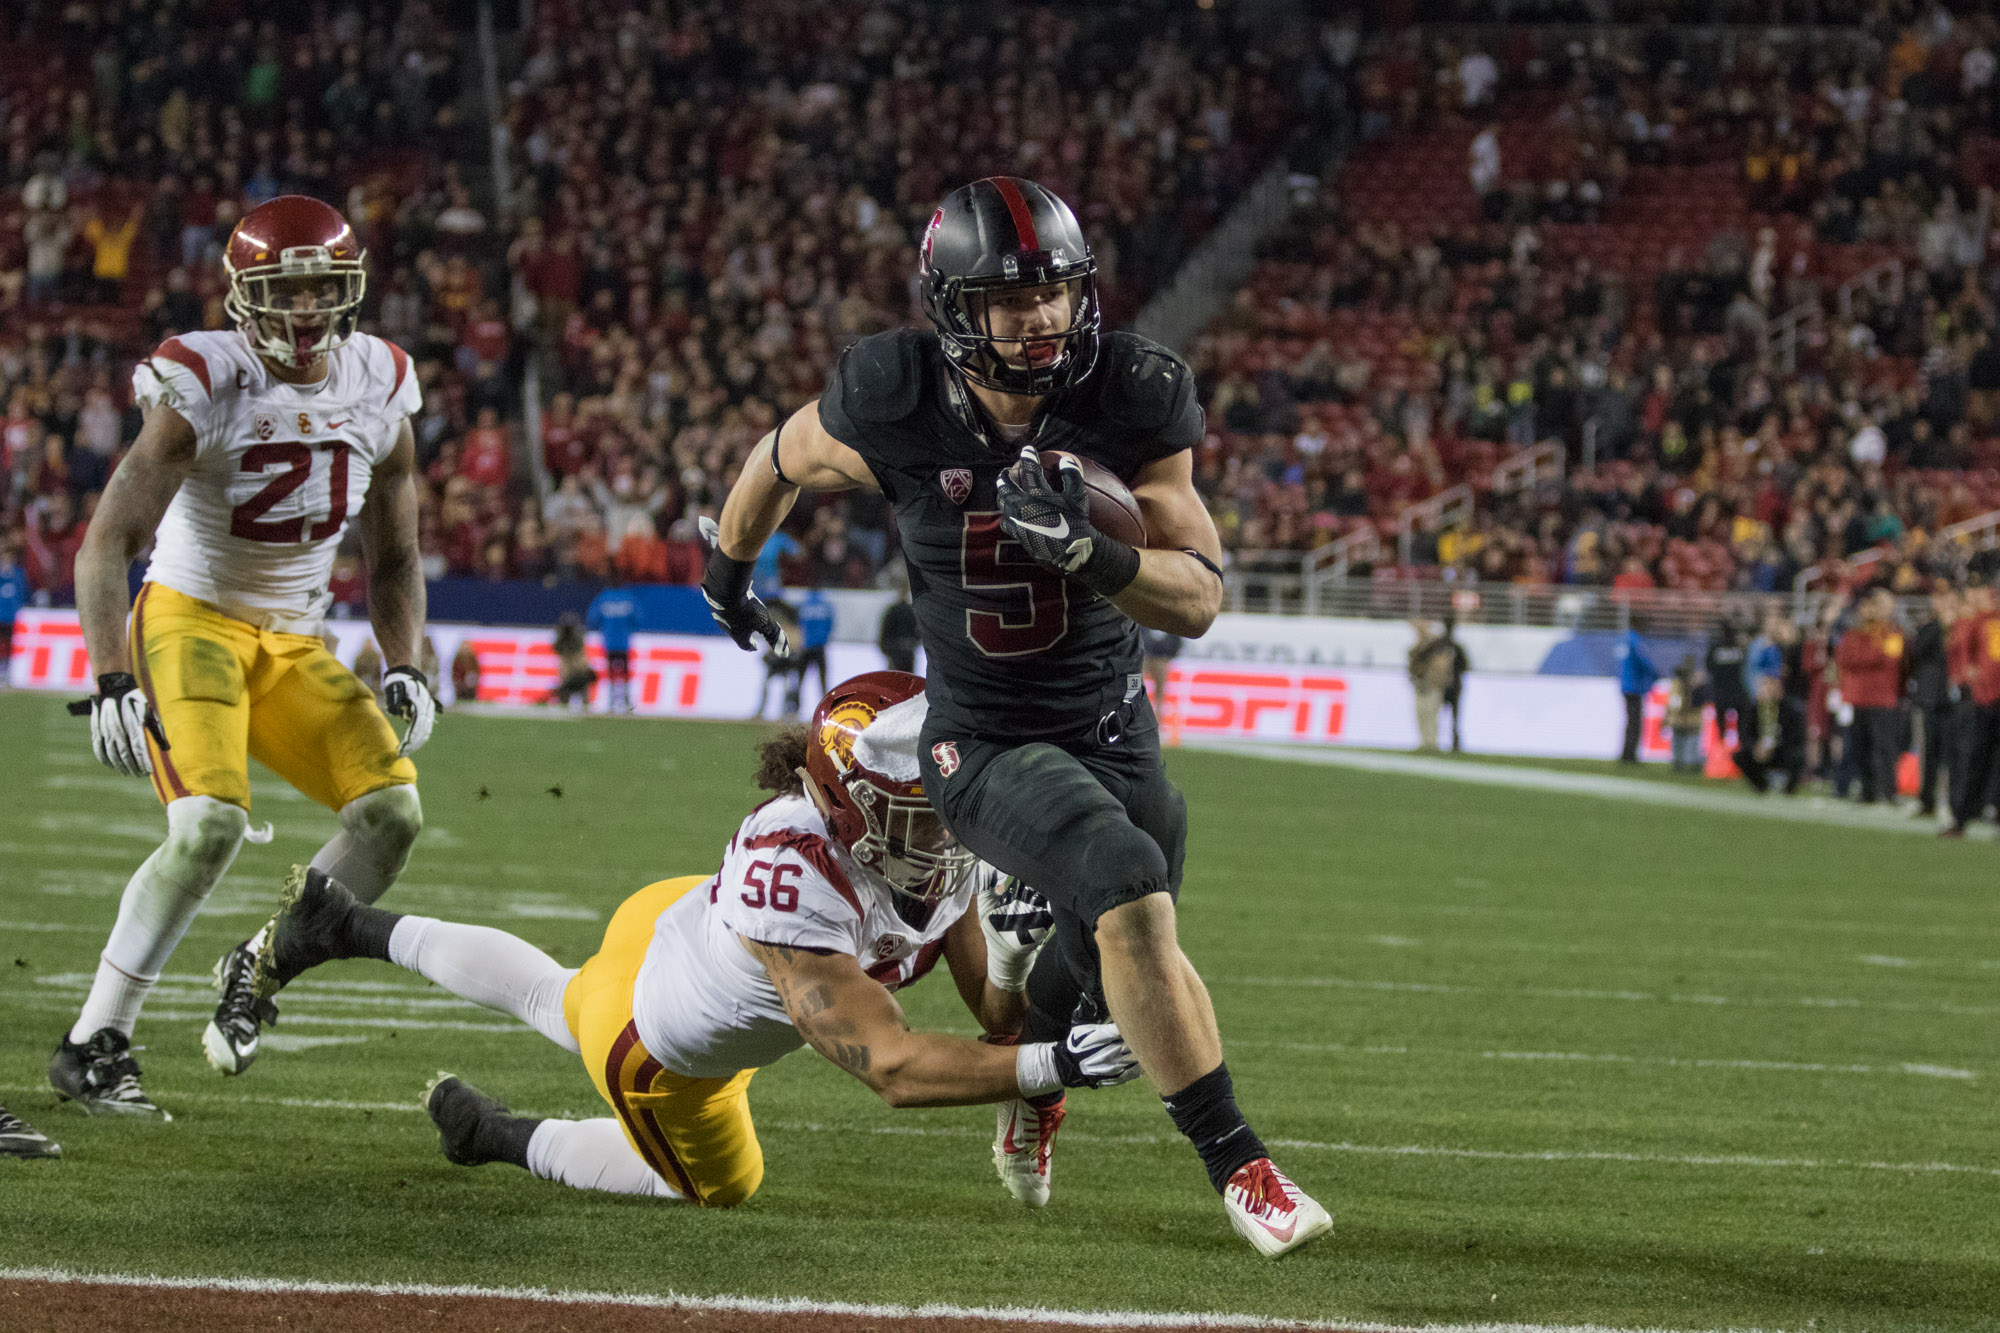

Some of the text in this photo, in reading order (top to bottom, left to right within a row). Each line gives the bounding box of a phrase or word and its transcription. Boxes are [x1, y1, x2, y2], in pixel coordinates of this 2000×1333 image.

[236, 369, 249, 389] C
[230, 440, 351, 543] 21
[950, 484, 966, 497] 12
[961, 511, 1068, 657] 5
[740, 859, 803, 913] 56
